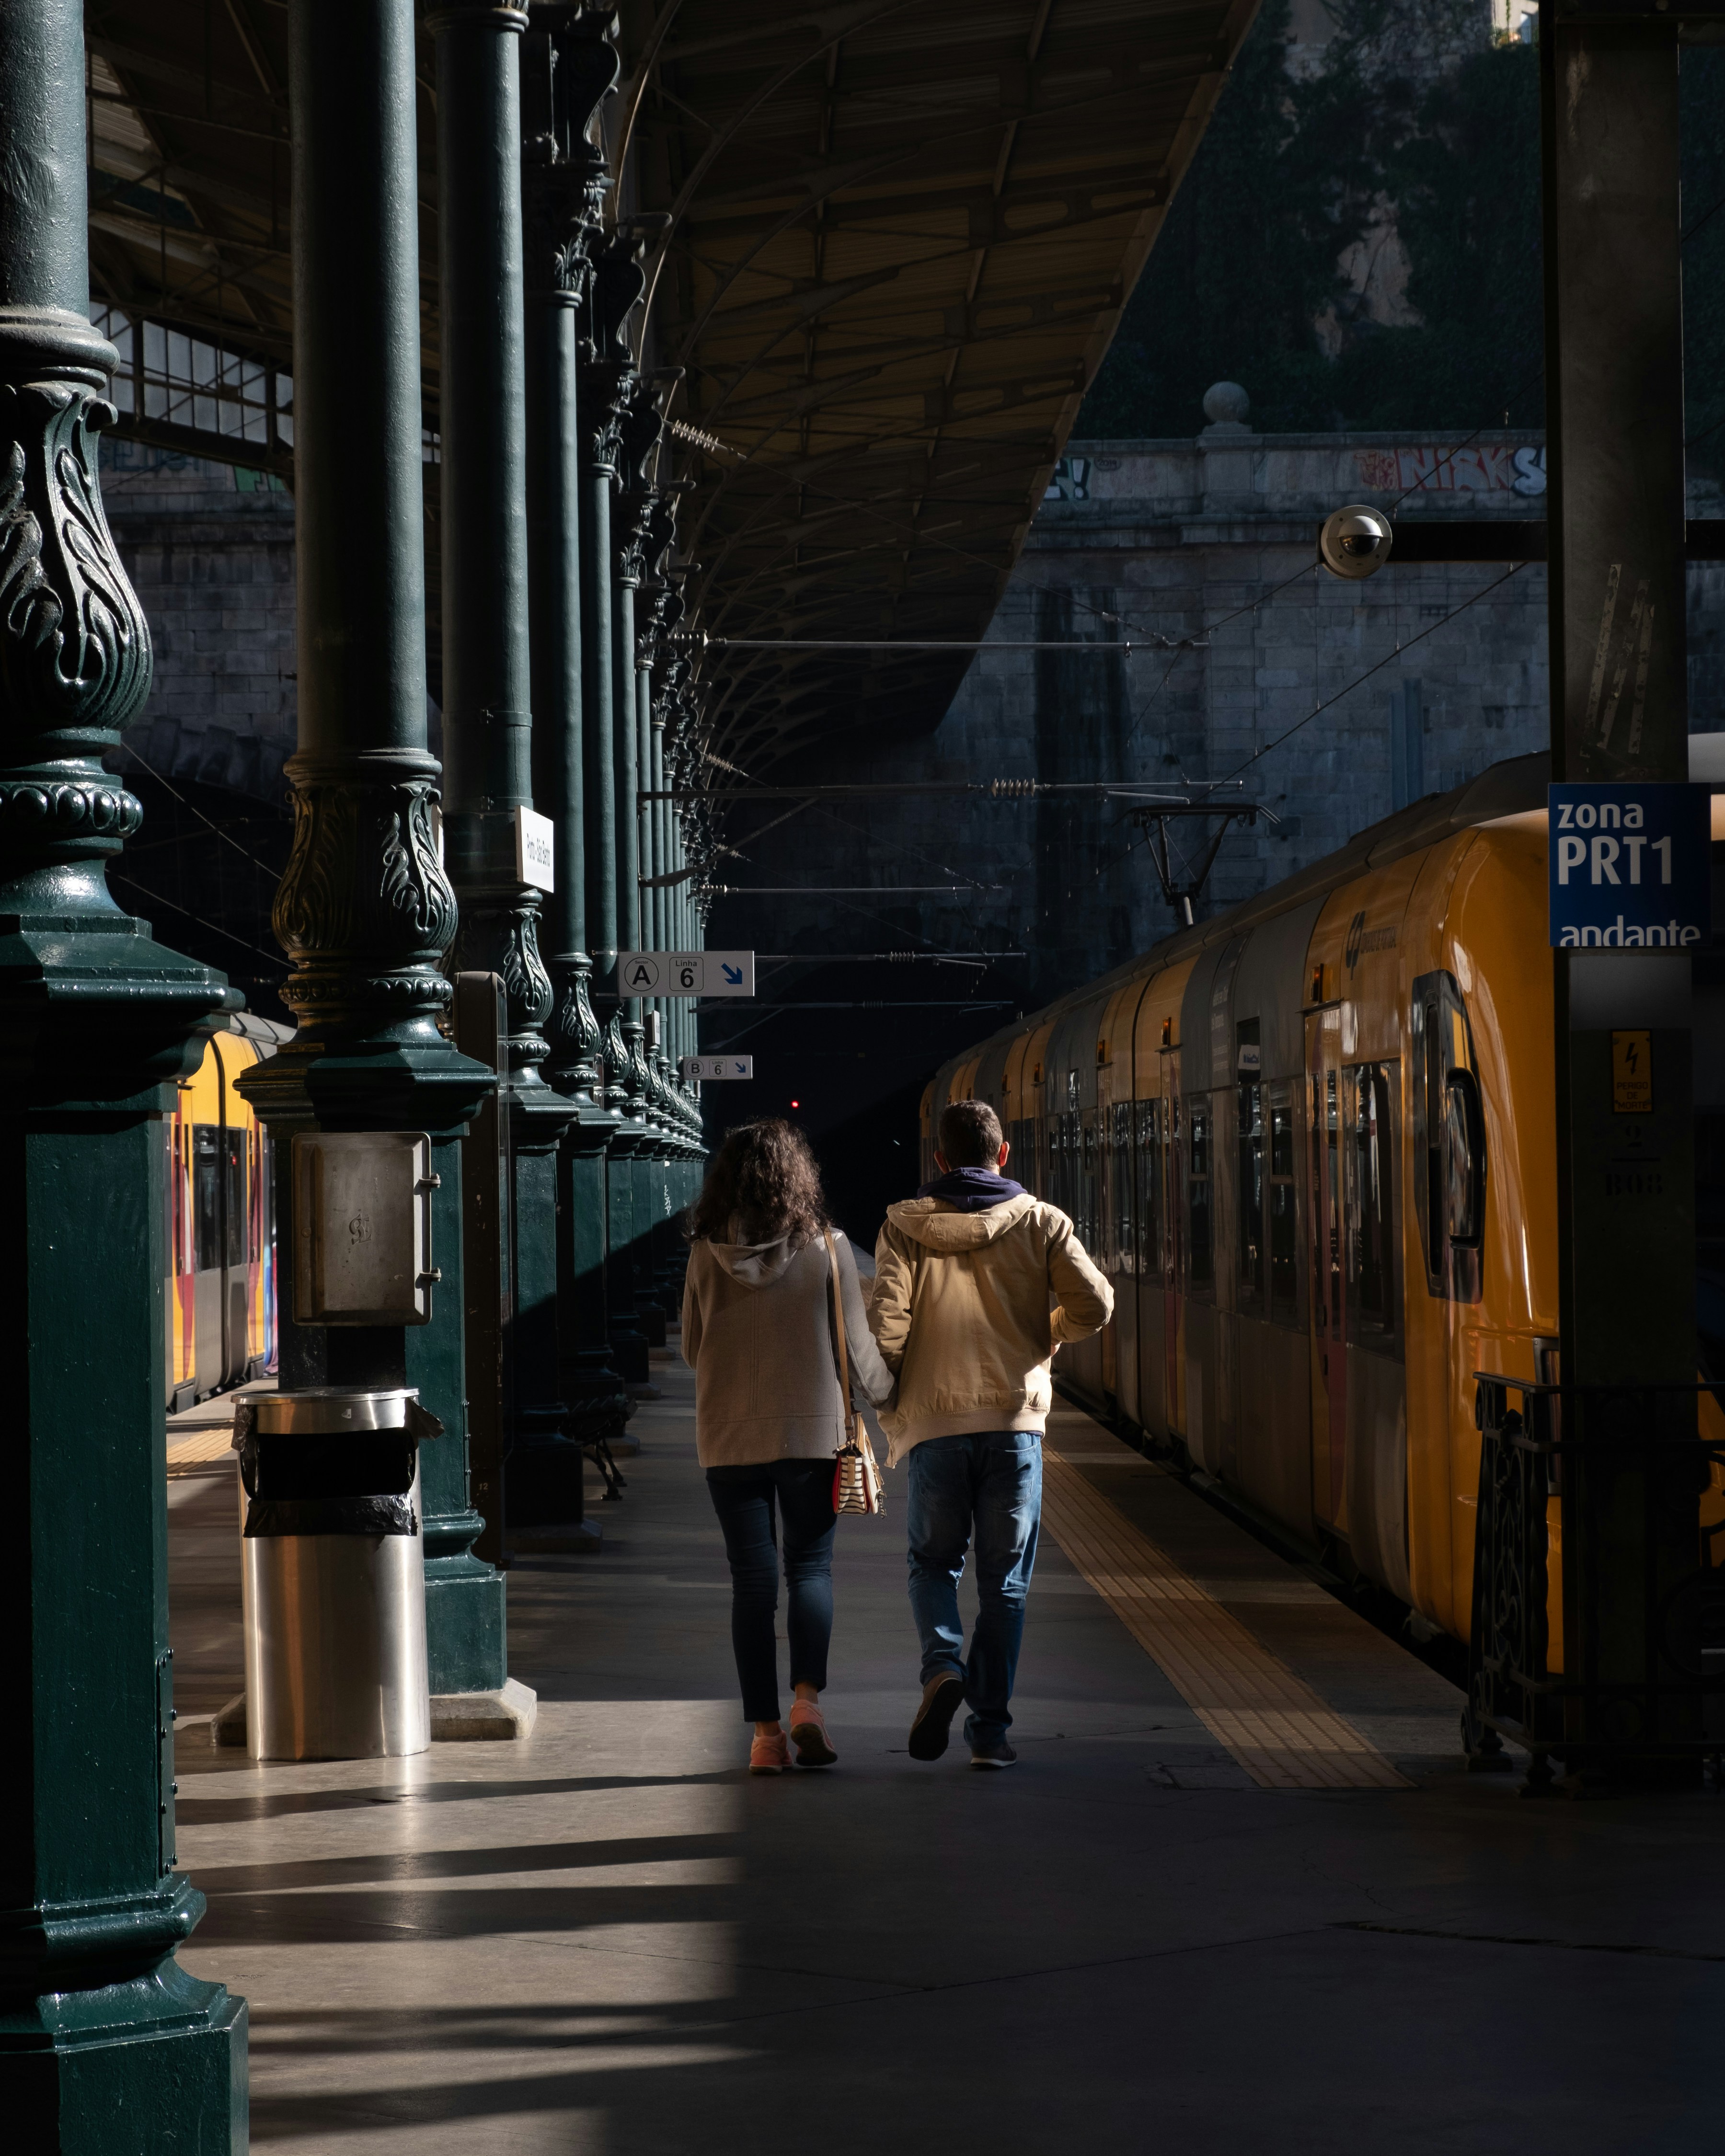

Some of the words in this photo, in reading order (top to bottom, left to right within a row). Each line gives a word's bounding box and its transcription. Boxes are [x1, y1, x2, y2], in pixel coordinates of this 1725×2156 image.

[1558, 803, 1644, 828] zona
[1558, 836, 1671, 885] PRT1
[632, 965, 651, 985] A
[680, 968, 694, 988] 6
[691, 1063, 700, 1073] B
[714, 1065, 722, 1075] 6
[1617, 1081, 1648, 1089] PERIGO
[478, 1482, 488, 1491] 12
